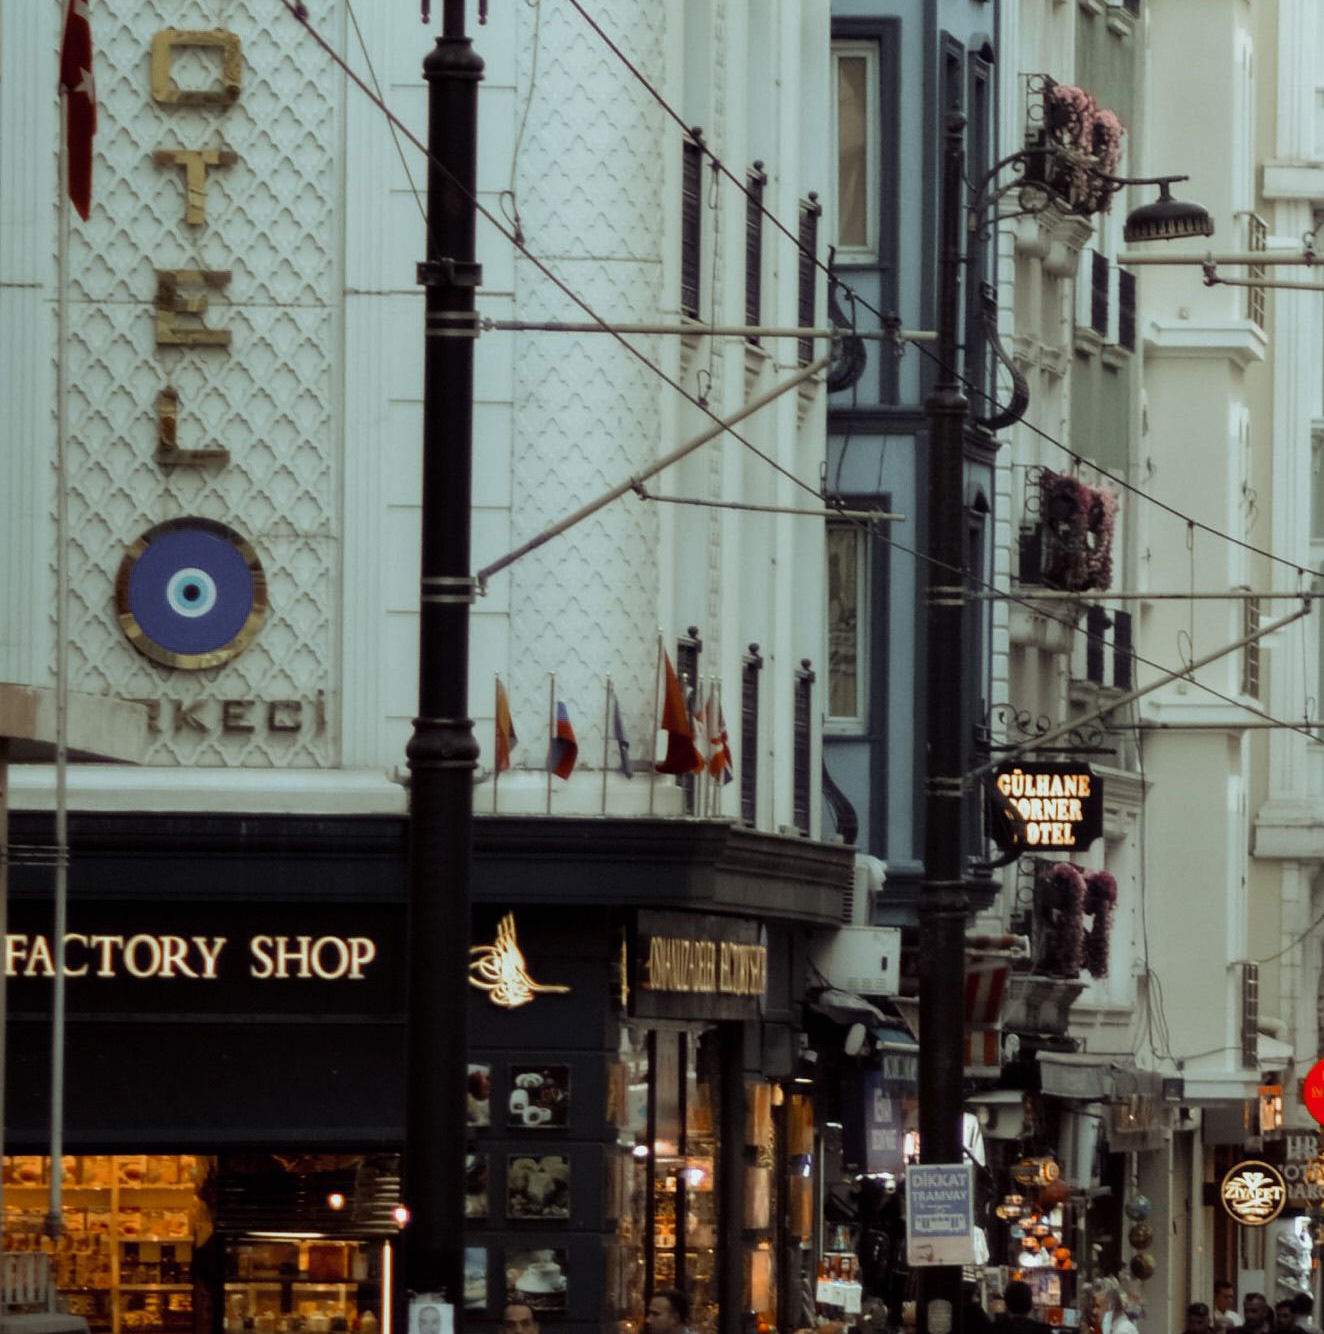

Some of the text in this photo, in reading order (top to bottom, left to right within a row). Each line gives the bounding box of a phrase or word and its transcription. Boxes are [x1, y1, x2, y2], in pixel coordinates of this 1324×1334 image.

[997, 768, 1091, 797] GÜLHANE
[1007, 798, 1083, 821] ORNER
[1022, 822, 1076, 845] OTEL
[4, 933, 376, 979] FACTORY SHOP
[912, 1171, 967, 1187] DİKKAT
[912, 1190, 967, 1202] TRAMVAY
